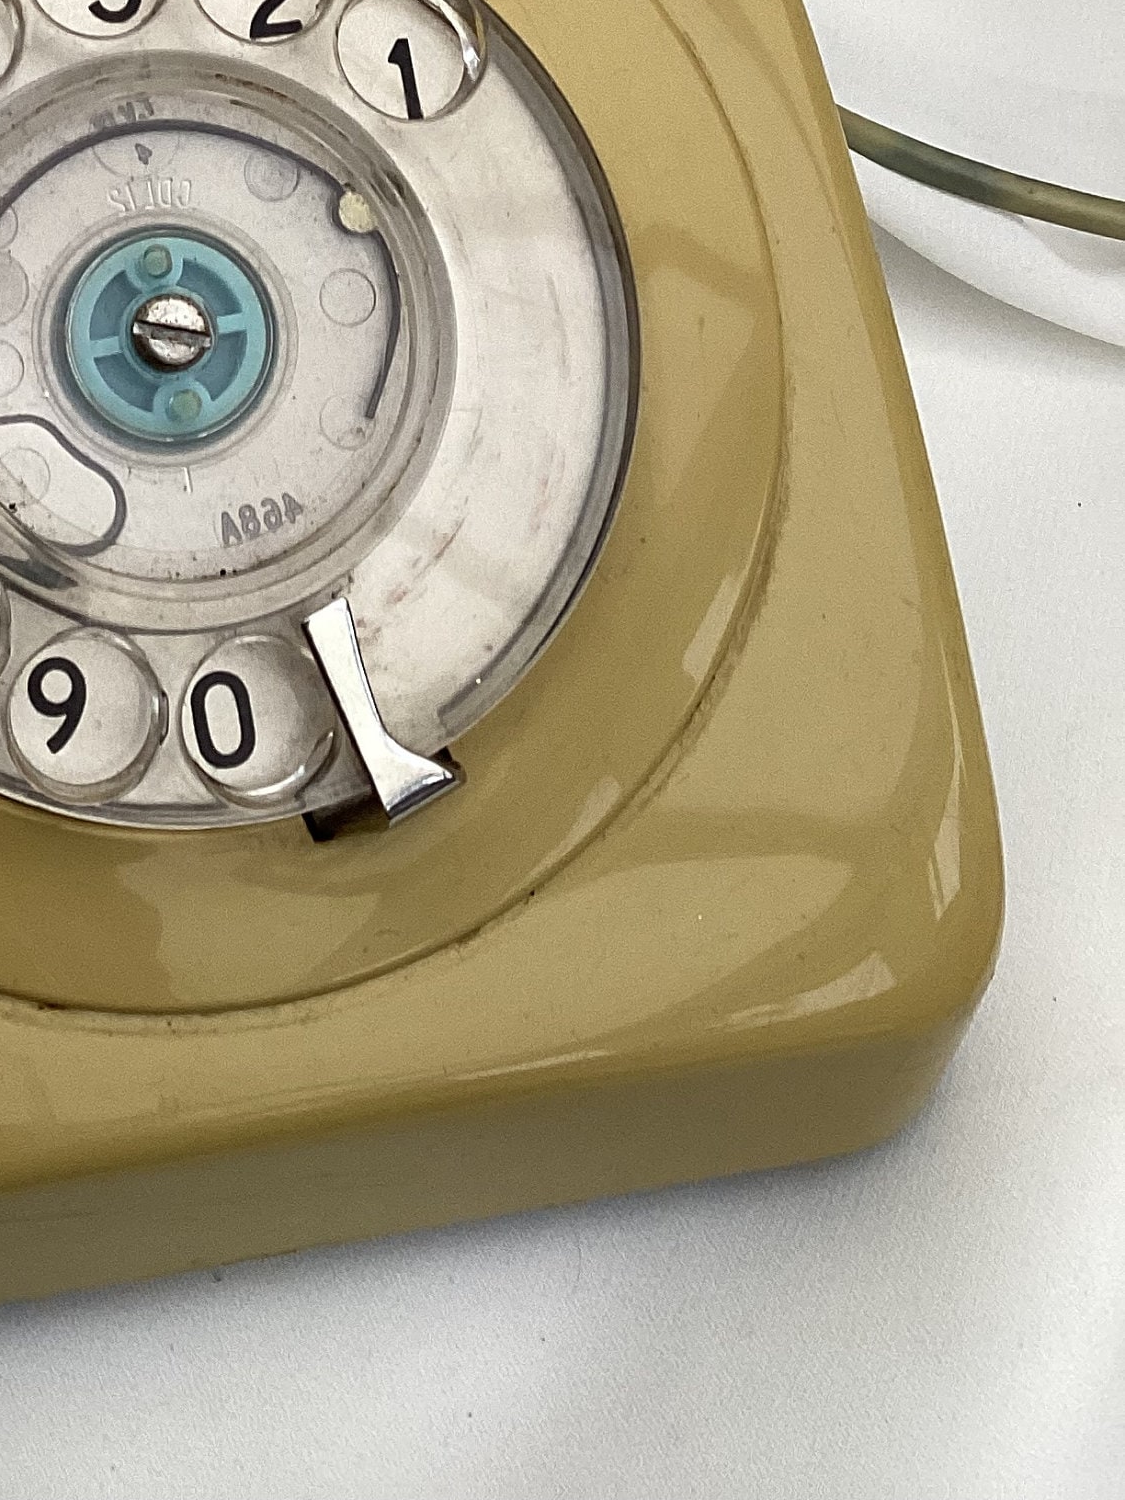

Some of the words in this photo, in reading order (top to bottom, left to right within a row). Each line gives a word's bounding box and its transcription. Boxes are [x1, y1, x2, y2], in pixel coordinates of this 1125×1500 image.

[387, 38, 424, 121] 1
[27, 656, 87, 754] 9
[190, 670, 256, 769] 0
